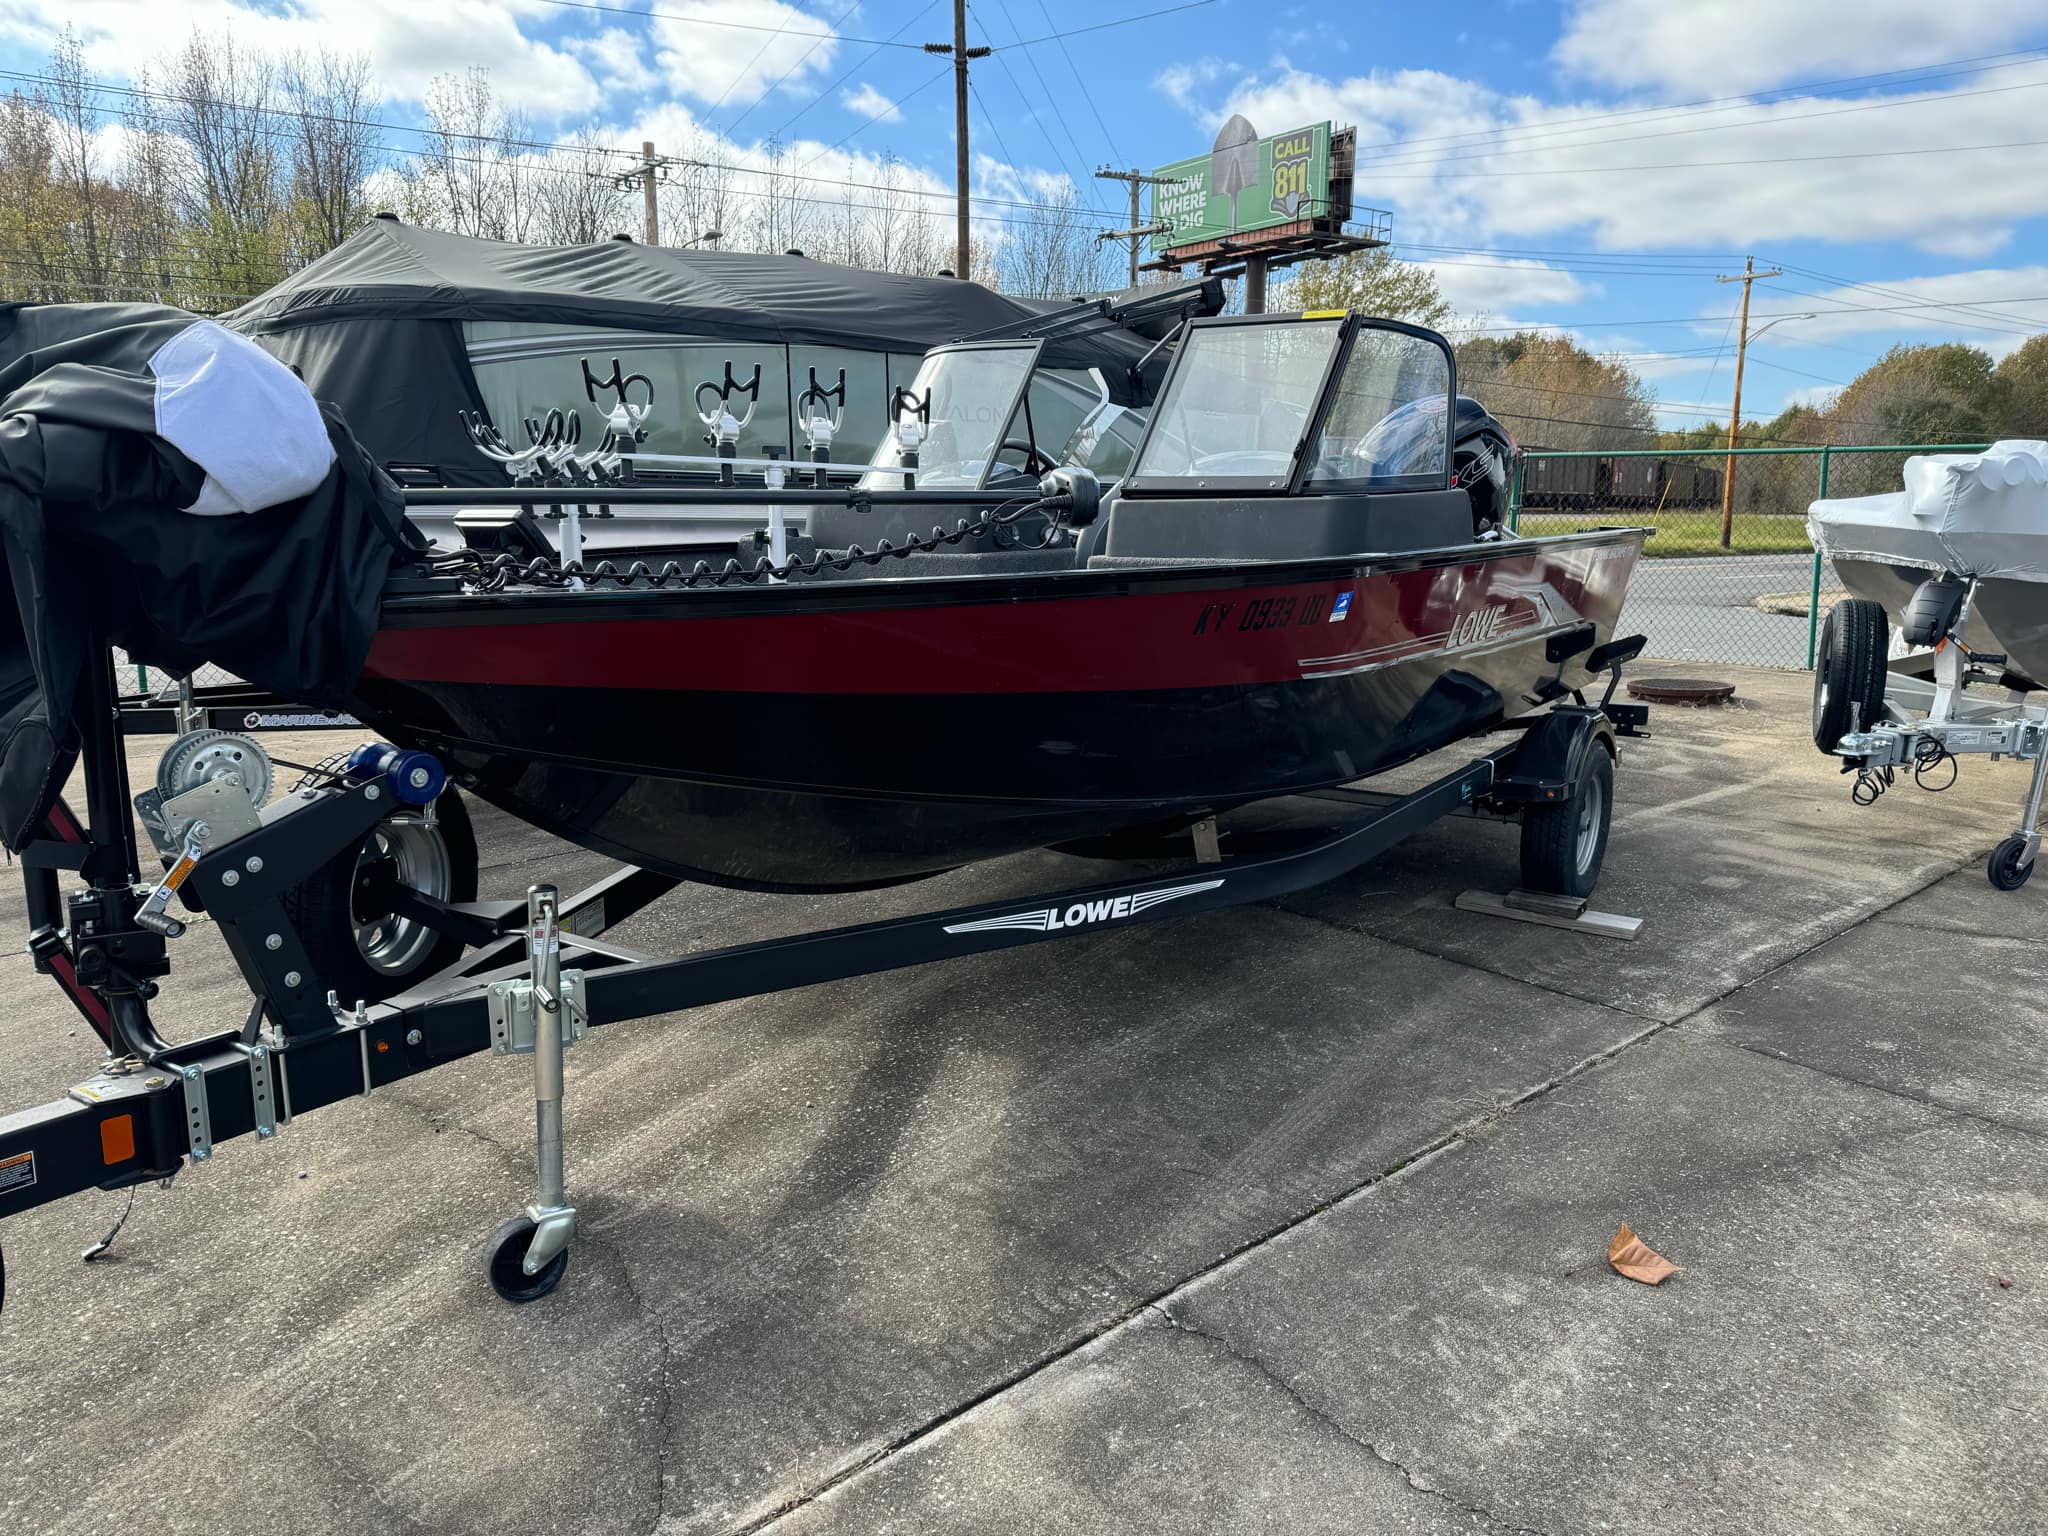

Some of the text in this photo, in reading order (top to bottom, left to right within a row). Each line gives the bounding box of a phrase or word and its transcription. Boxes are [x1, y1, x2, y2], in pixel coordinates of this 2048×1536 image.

[1275, 136, 1310, 159] CALL
[1159, 171, 1205, 199] KNOW
[1275, 162, 1306, 199] 811
[1159, 190, 1207, 217] WHERE
[1180, 210, 1204, 231] DIG
[1193, 602, 1236, 635] KY
[1238, 597, 1298, 632] 0933
[1445, 604, 1507, 649] LOWE
[1047, 895, 1132, 931] LOWE
